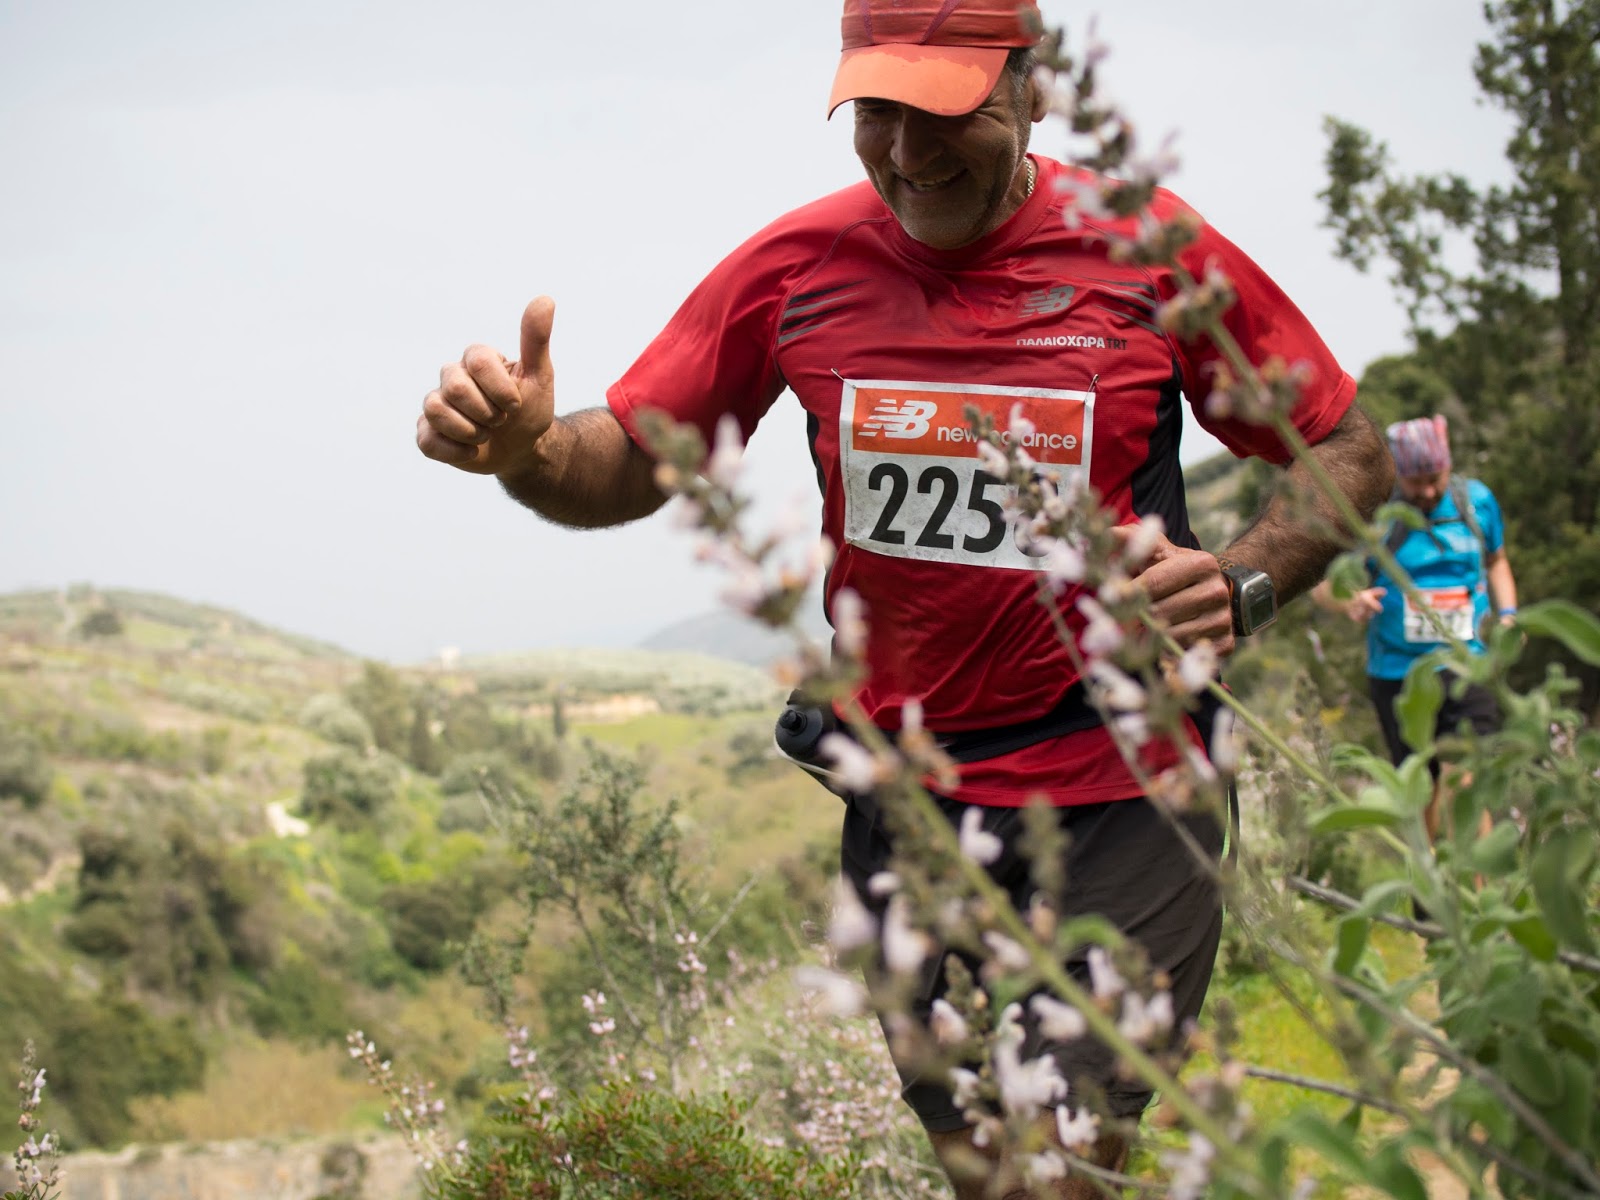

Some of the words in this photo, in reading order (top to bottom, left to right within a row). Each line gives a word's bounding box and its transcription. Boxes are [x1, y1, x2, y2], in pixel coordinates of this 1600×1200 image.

[857, 398, 937, 440] NB
[937, 426, 979, 443] new
[989, 425, 1077, 450] aance
